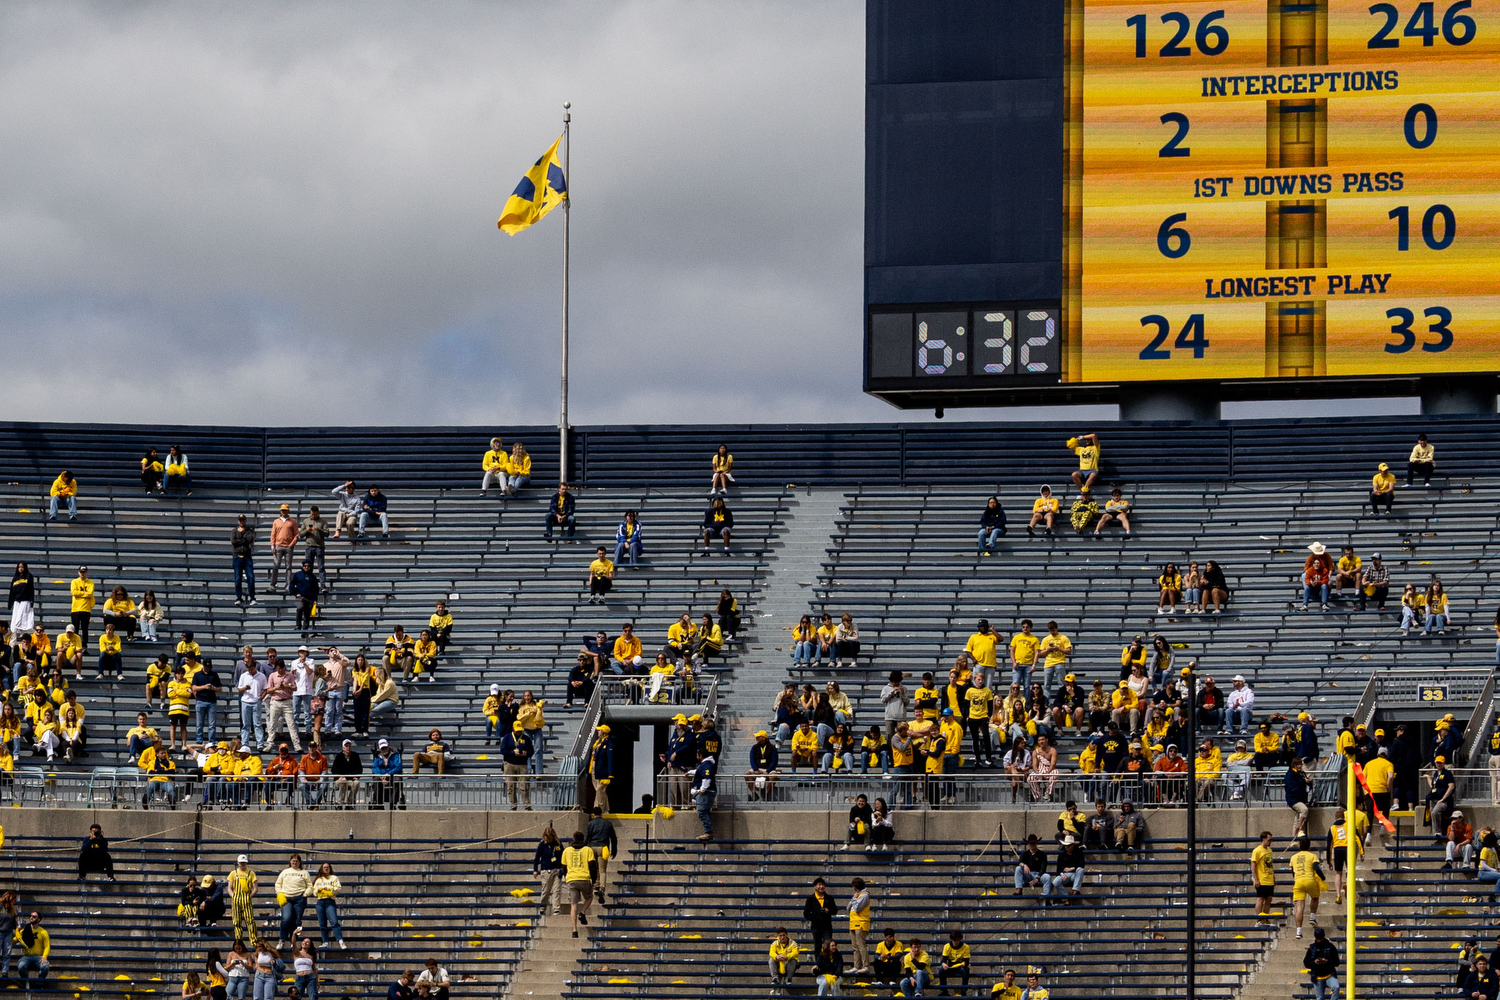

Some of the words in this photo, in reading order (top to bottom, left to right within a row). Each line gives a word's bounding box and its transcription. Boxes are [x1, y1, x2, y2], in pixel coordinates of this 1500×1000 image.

[1126, 10, 1229, 58] 126
[1368, 0, 1476, 49] 246
[1202, 70, 1398, 96] INTERCEPTIONS
[1159, 112, 1190, 157] 2
[1404, 103, 1437, 149] 0
[1194, 177, 1233, 197] 1ST
[1244, 174, 1331, 196] DOWNS
[1343, 172, 1403, 192] PASS
[1157, 213, 1191, 258] 6
[1389, 205, 1456, 251] 10
[1206, 276, 1316, 298] LONGEST
[1327, 274, 1391, 294] PLAY
[1139, 314, 1209, 360] 24
[1384, 307, 1453, 354] 33
[1423, 690, 1444, 700] 33
